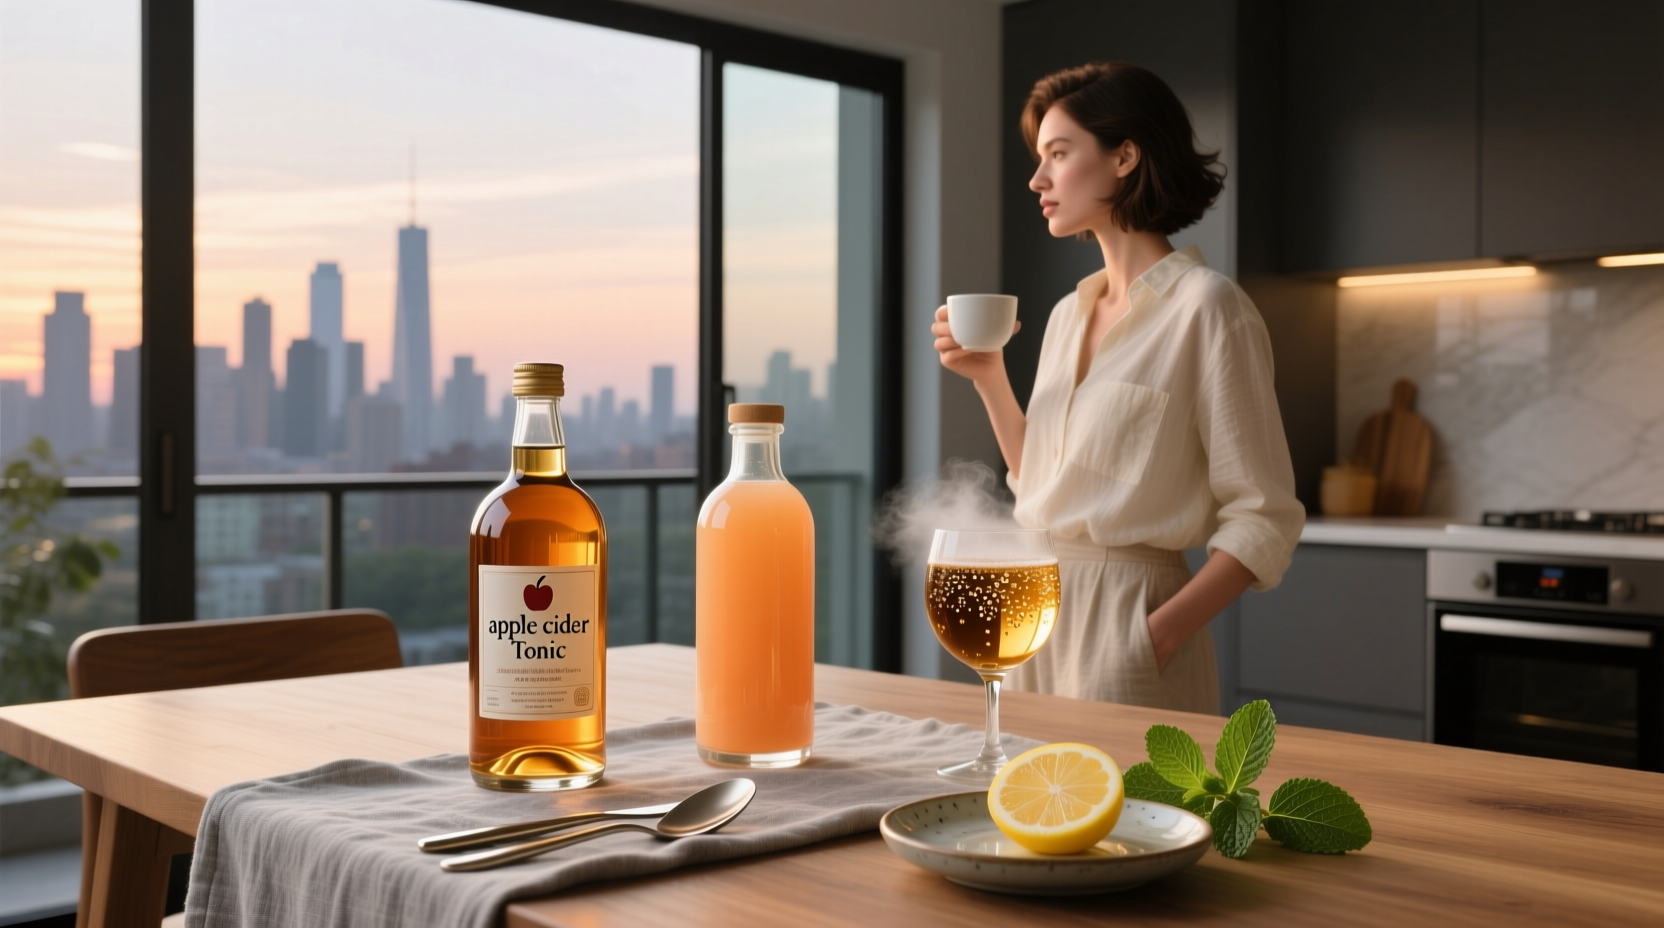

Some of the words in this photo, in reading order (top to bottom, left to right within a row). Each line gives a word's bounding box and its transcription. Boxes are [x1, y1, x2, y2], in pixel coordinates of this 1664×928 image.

[489, 614, 538, 641] apple
[543, 613, 589, 634] cider
[511, 640, 566, 659] Tonic
